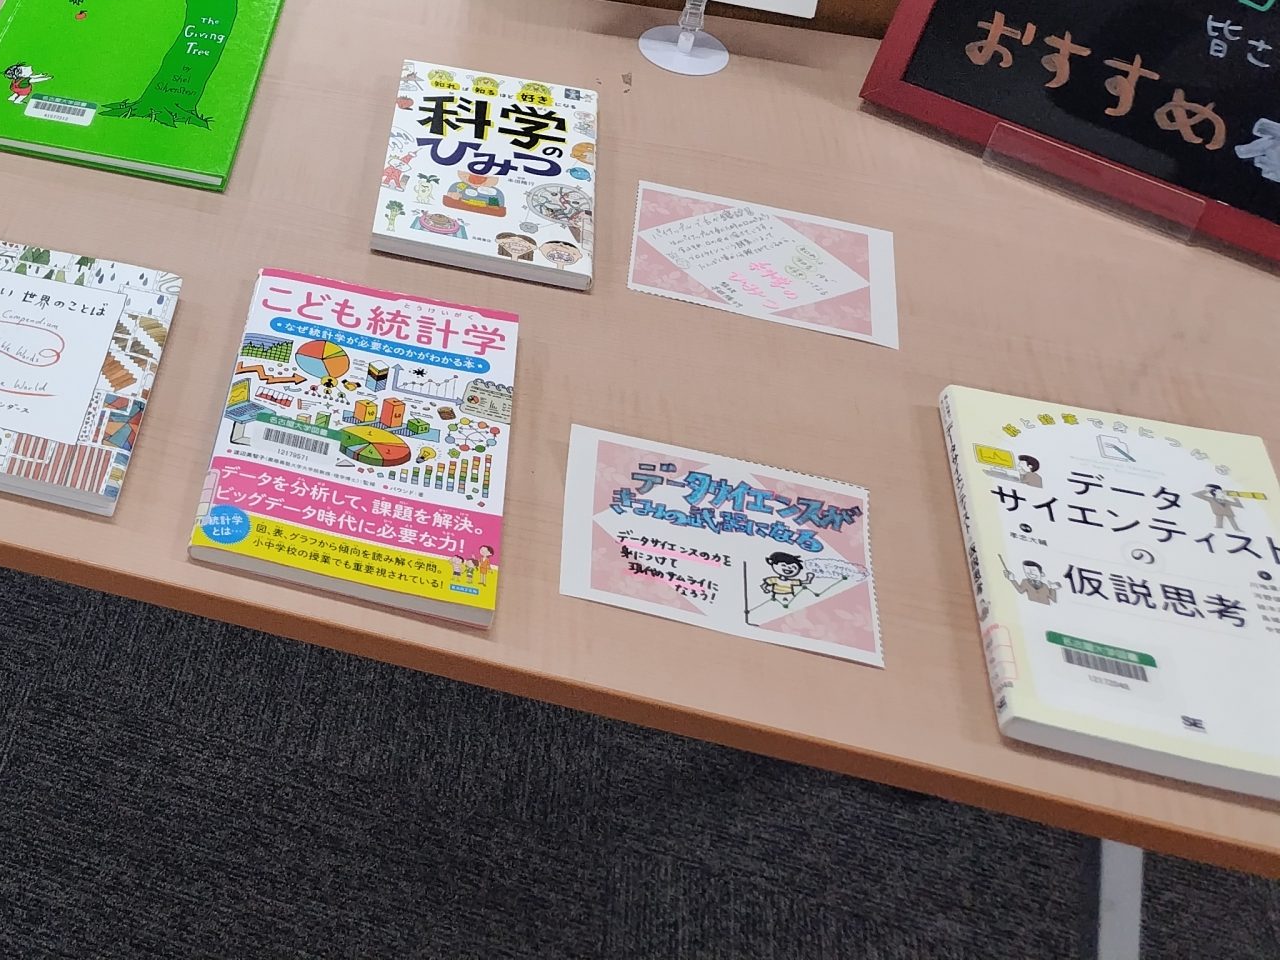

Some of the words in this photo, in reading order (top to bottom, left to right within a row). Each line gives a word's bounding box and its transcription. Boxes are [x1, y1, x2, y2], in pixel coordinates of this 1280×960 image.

[186, 41, 210, 57] Tree
[964, 10, 1228, 151] おすすめ
[415, 136, 562, 177] ひみつ
[22, 290, 109, 318] 世界のことば
[261, 286, 507, 357] こども統計学
[284, 321, 479, 370] なぜ統計学が必要なのかがわかる本
[220, 465, 485, 537] データを分析して、課題を解決。
[1066, 470, 1182, 512] データ
[215, 484, 466, 554] ビッグデータ時代に必要な力!
[1130, 547, 1156, 565] の
[1063, 563, 1247, 629] 仮説思考
